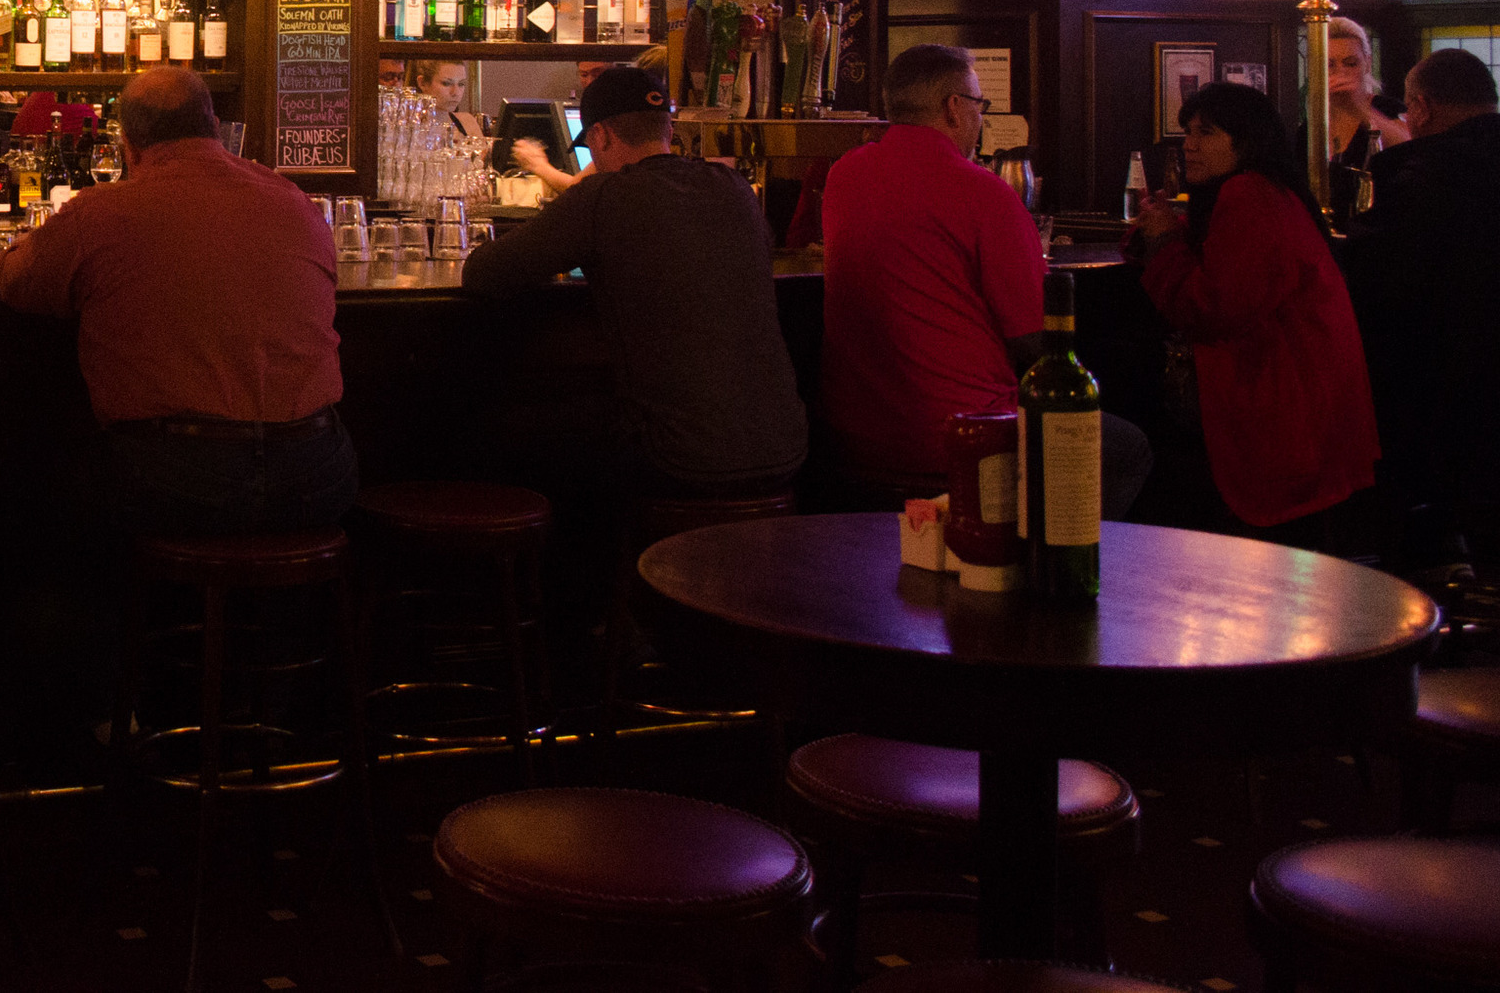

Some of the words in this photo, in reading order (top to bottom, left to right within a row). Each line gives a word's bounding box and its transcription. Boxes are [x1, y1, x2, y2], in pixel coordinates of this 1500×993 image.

[279, 8, 314, 22] SOLEMN
[319, 9, 344, 21] OATH
[279, 21, 317, 31] KIDNAPPED
[281, 34, 322, 49] DOGFISH
[323, 35, 346, 47] HEAD
[287, 45, 305, 59] 60
[305, 46, 321, 59] MIN
[325, 46, 341, 59] IPA
[280, 94, 317, 113] GOOSE
[319, 93, 349, 112] ISLAND
[328, 109, 346, 124] RYE
